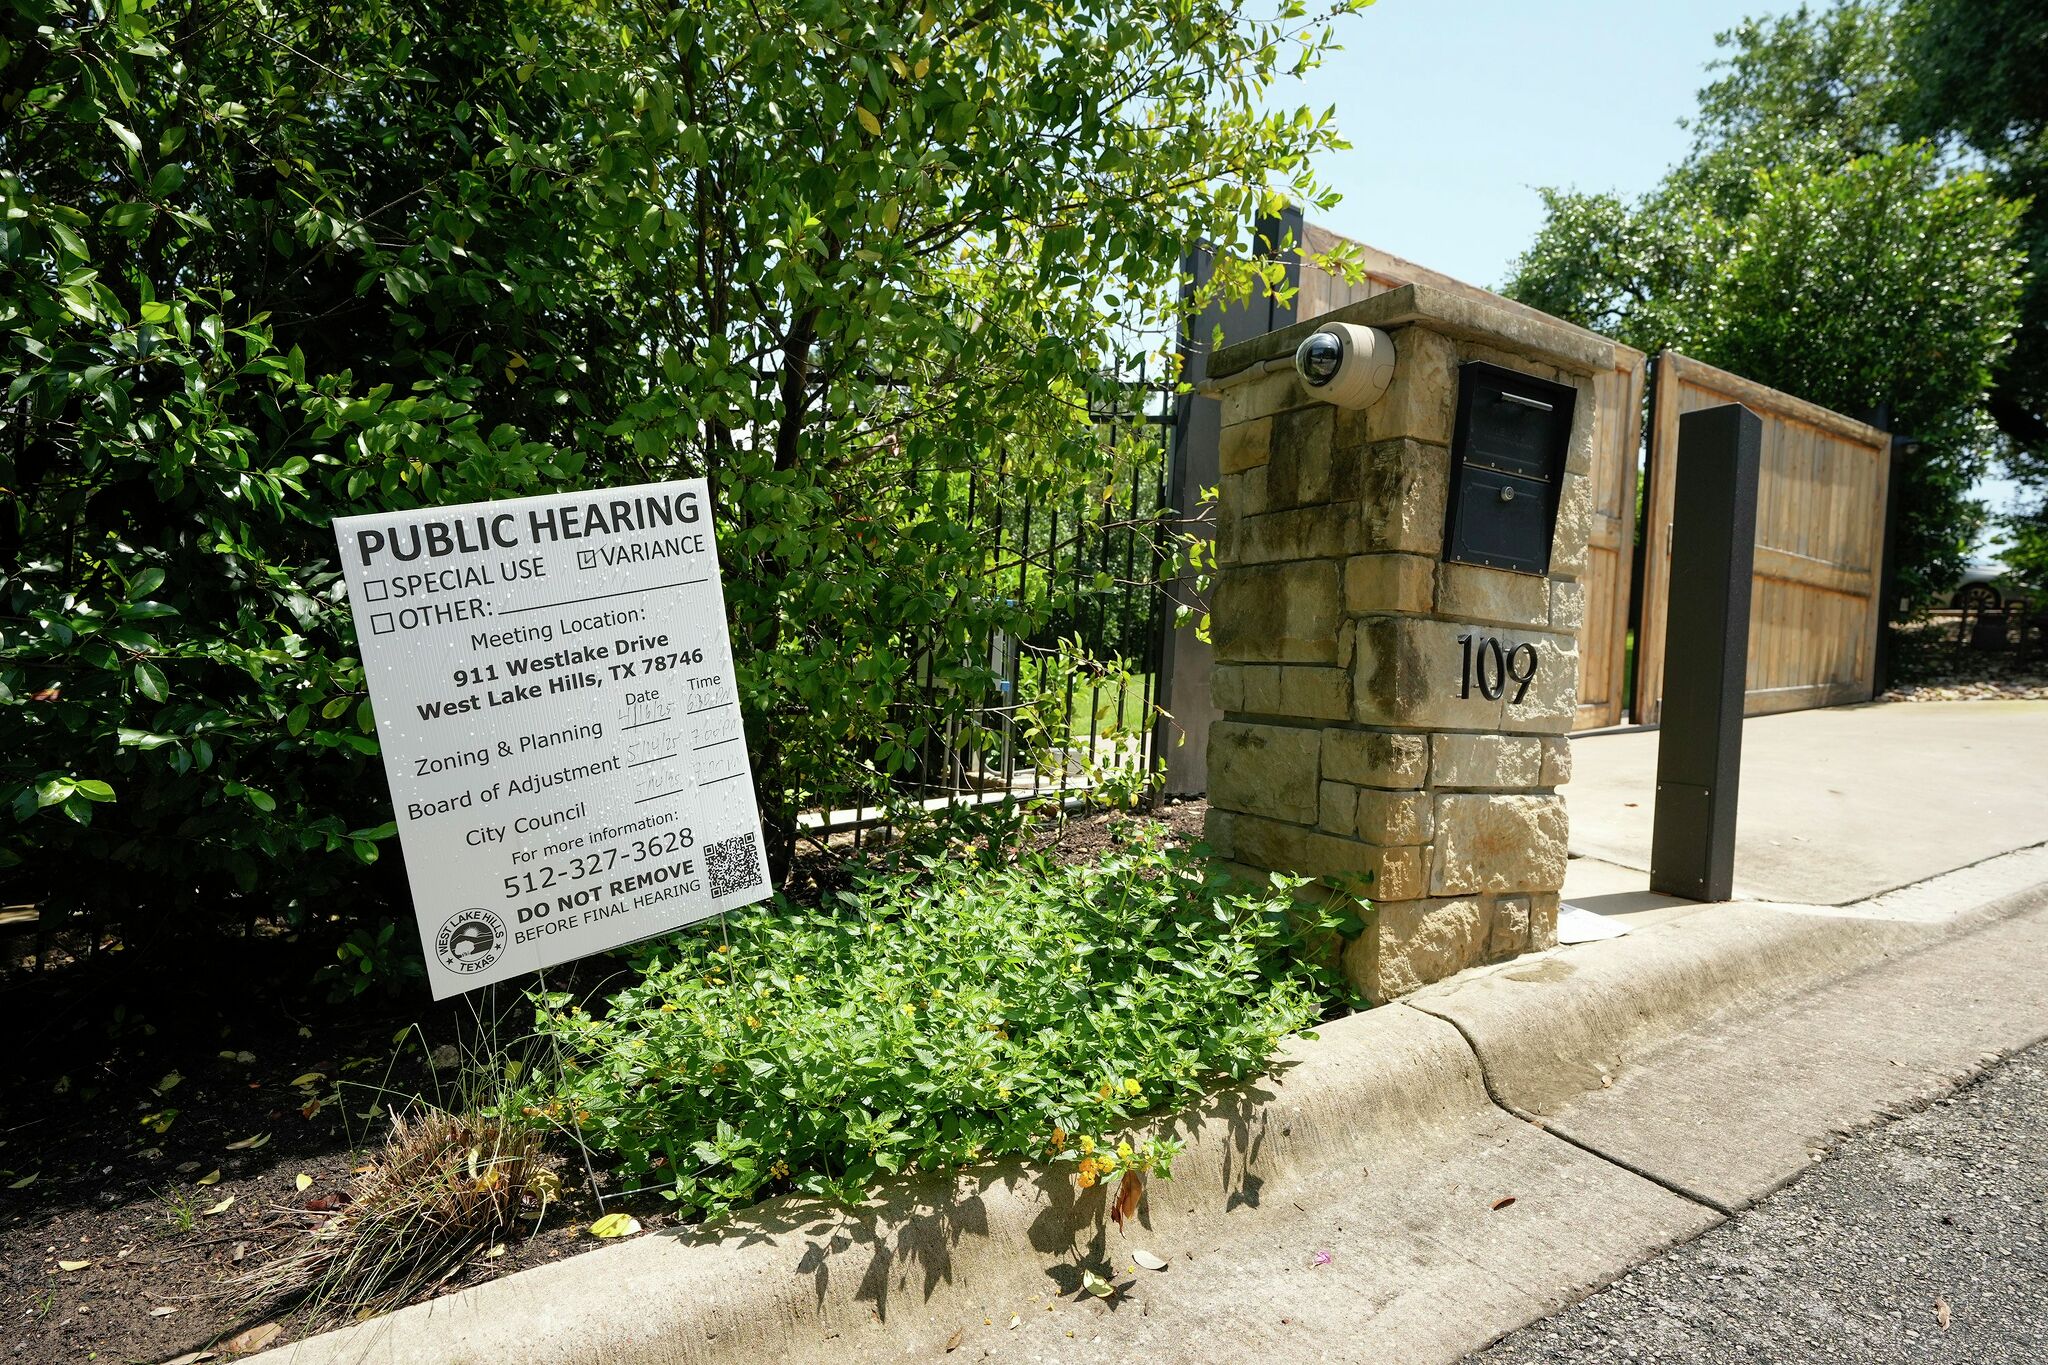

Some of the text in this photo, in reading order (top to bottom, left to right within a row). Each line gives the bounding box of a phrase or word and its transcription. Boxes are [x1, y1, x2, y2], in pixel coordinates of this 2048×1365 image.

[356, 492, 700, 567] PUBLIC HEARING
[600, 534, 705, 567] VARIANCE
[391, 557, 546, 598] SPECIAL USE
[399, 598, 493, 630] OTHER:
[471, 608, 646, 651] Meeting Location:
[416, 648, 704, 721] West Lake Hills, TX 78746
[453, 634, 669, 688] 911 Westlake Drive
[687, 675, 721, 690] Time
[1457, 635, 1538, 705] 109
[625, 689, 660, 706] Date
[414, 722, 603, 776] Zoning & Planning
[407, 755, 621, 820] Board of Adjustment
[465, 802, 586, 846] City Council
[512, 811, 679, 865] For more information:
[503, 827, 694, 899] 512-327-3628
[514, 879, 701, 944] BEFORE FINAL HEARING
[516, 860, 695, 924] DO NOT REMOVE
[438, 911, 504, 956] WEST LAKE HILLS
[460, 954, 495, 972] TEXAS
